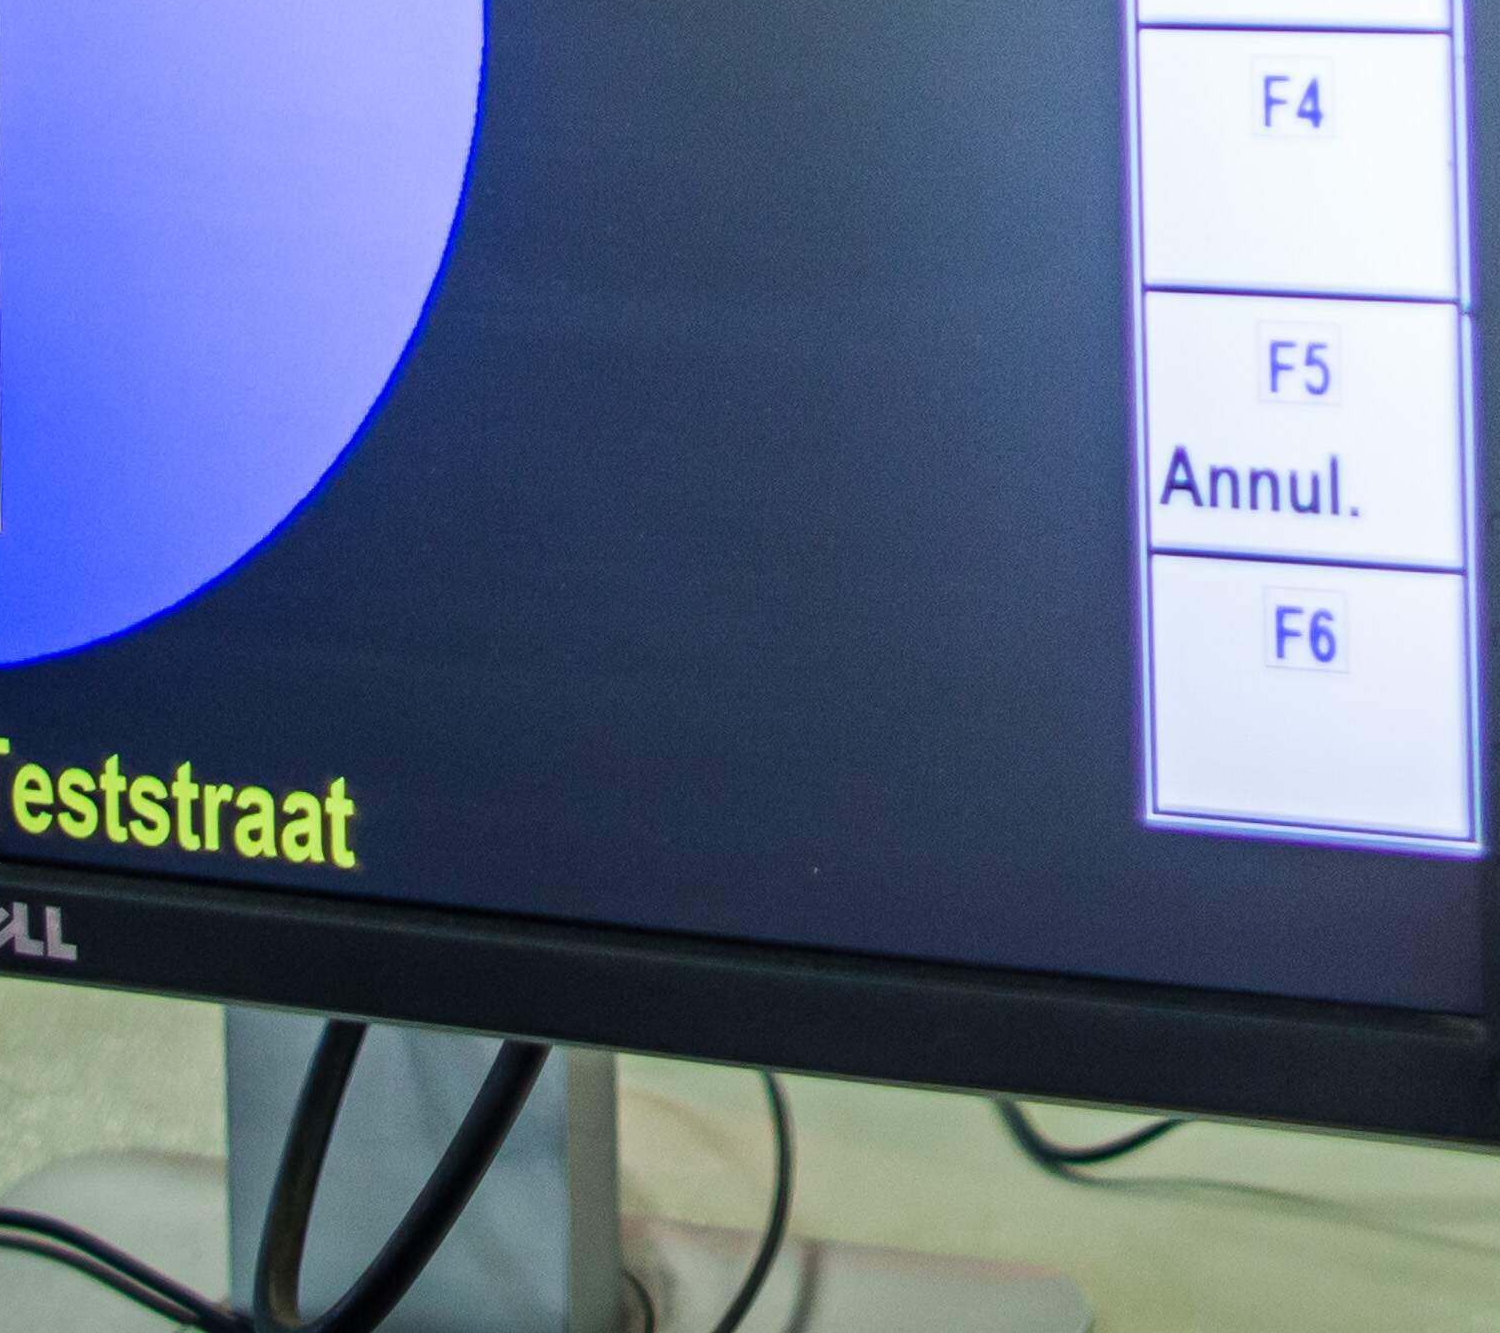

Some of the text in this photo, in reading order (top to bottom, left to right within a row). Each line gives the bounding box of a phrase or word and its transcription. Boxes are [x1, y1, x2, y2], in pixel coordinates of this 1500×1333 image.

[1261, 73, 1326, 130] F4
[1267, 338, 1333, 398] F5
[1156, 443, 1361, 519] Annul.
[1272, 603, 1340, 666] F6
